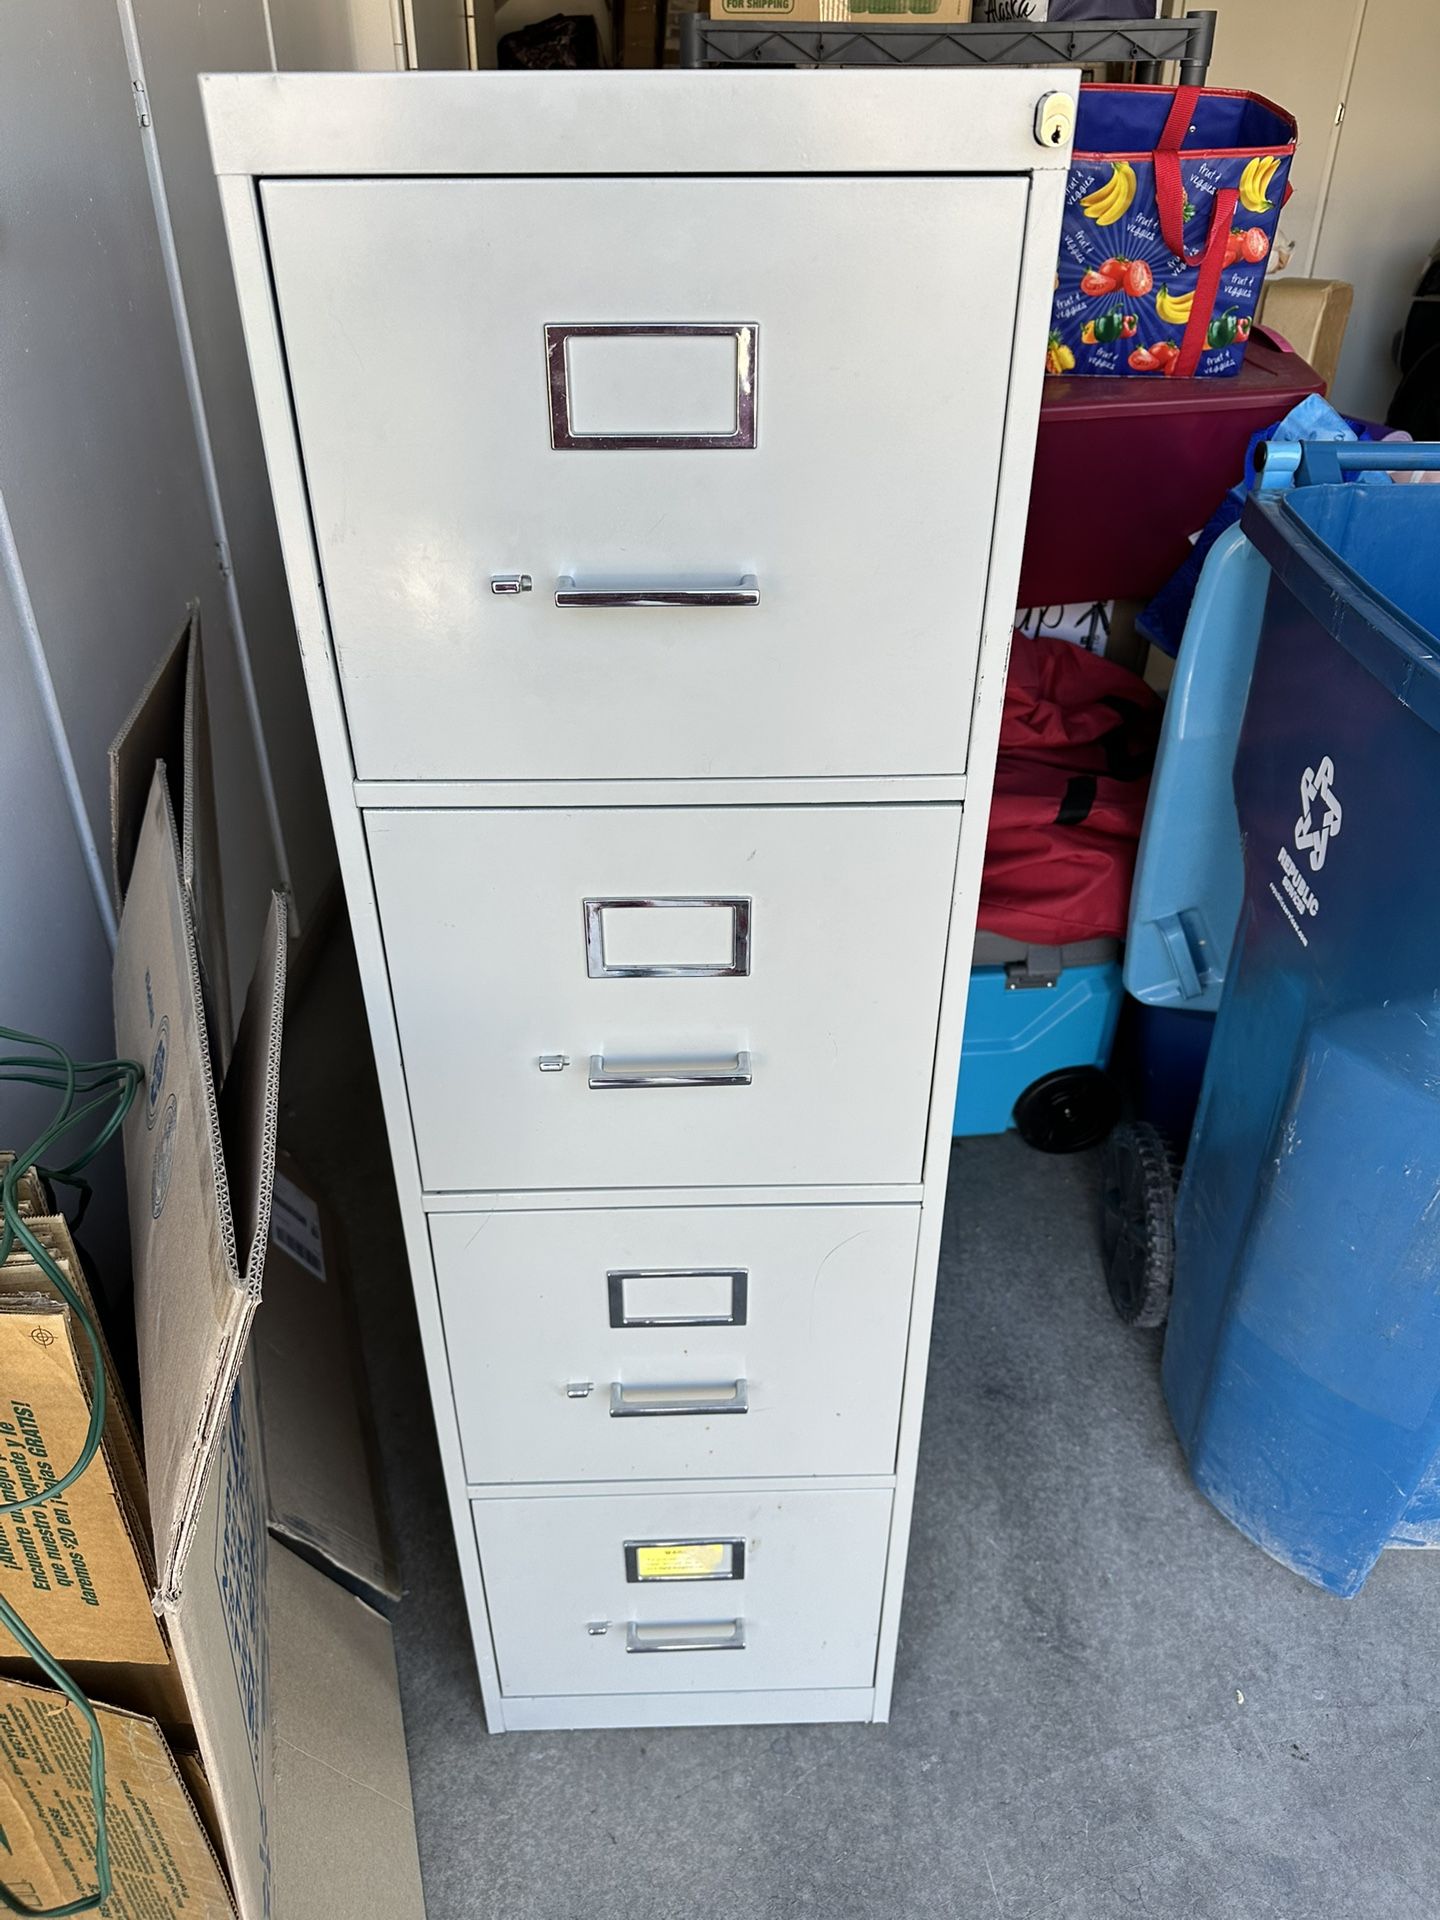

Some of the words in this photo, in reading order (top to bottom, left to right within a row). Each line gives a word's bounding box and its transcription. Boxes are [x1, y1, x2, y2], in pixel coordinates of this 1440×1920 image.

[726, 0, 744, 8] FOR
[747, 0, 789, 8] SHIPPING
[1199, 163, 1216, 180] fruit
[1067, 176, 1095, 206] veggies
[1190, 174, 1217, 195] veggies
[1136, 212, 1153, 227] fruit
[1075, 230, 1089, 247] fruit
[1127, 224, 1155, 240] veggies
[1065, 234, 1085, 264] veggies
[1231, 272, 1248, 286] fruit
[1225, 285, 1252, 297] veggies
[1056, 295, 1074, 309] fruit
[1056, 302, 1087, 318] veggies
[1096, 347, 1112, 359] fruit
[1206, 353, 1224, 366] fruit
[1089, 357, 1116, 370] veggies
[1204, 360, 1236, 374] veggies
[1277, 846, 1319, 916] REPUBLIC
[1281, 875, 1306, 915] SERVICES
[11, 1400, 48, 1458] GRATIS!
[5, 1438, 26, 1449] y
[53, 1508, 71, 1525] en
[32, 1510, 62, 1562] nuestro
[57, 1527, 79, 1550] $20
[17, 1525, 51, 1591] Encuentre
[51, 1561, 75, 1587] que
[69, 1552, 100, 1607] daremos
[0, 1713, 30, 1759] RECYCLE
[48, 1807, 73, 1838] REUSE
